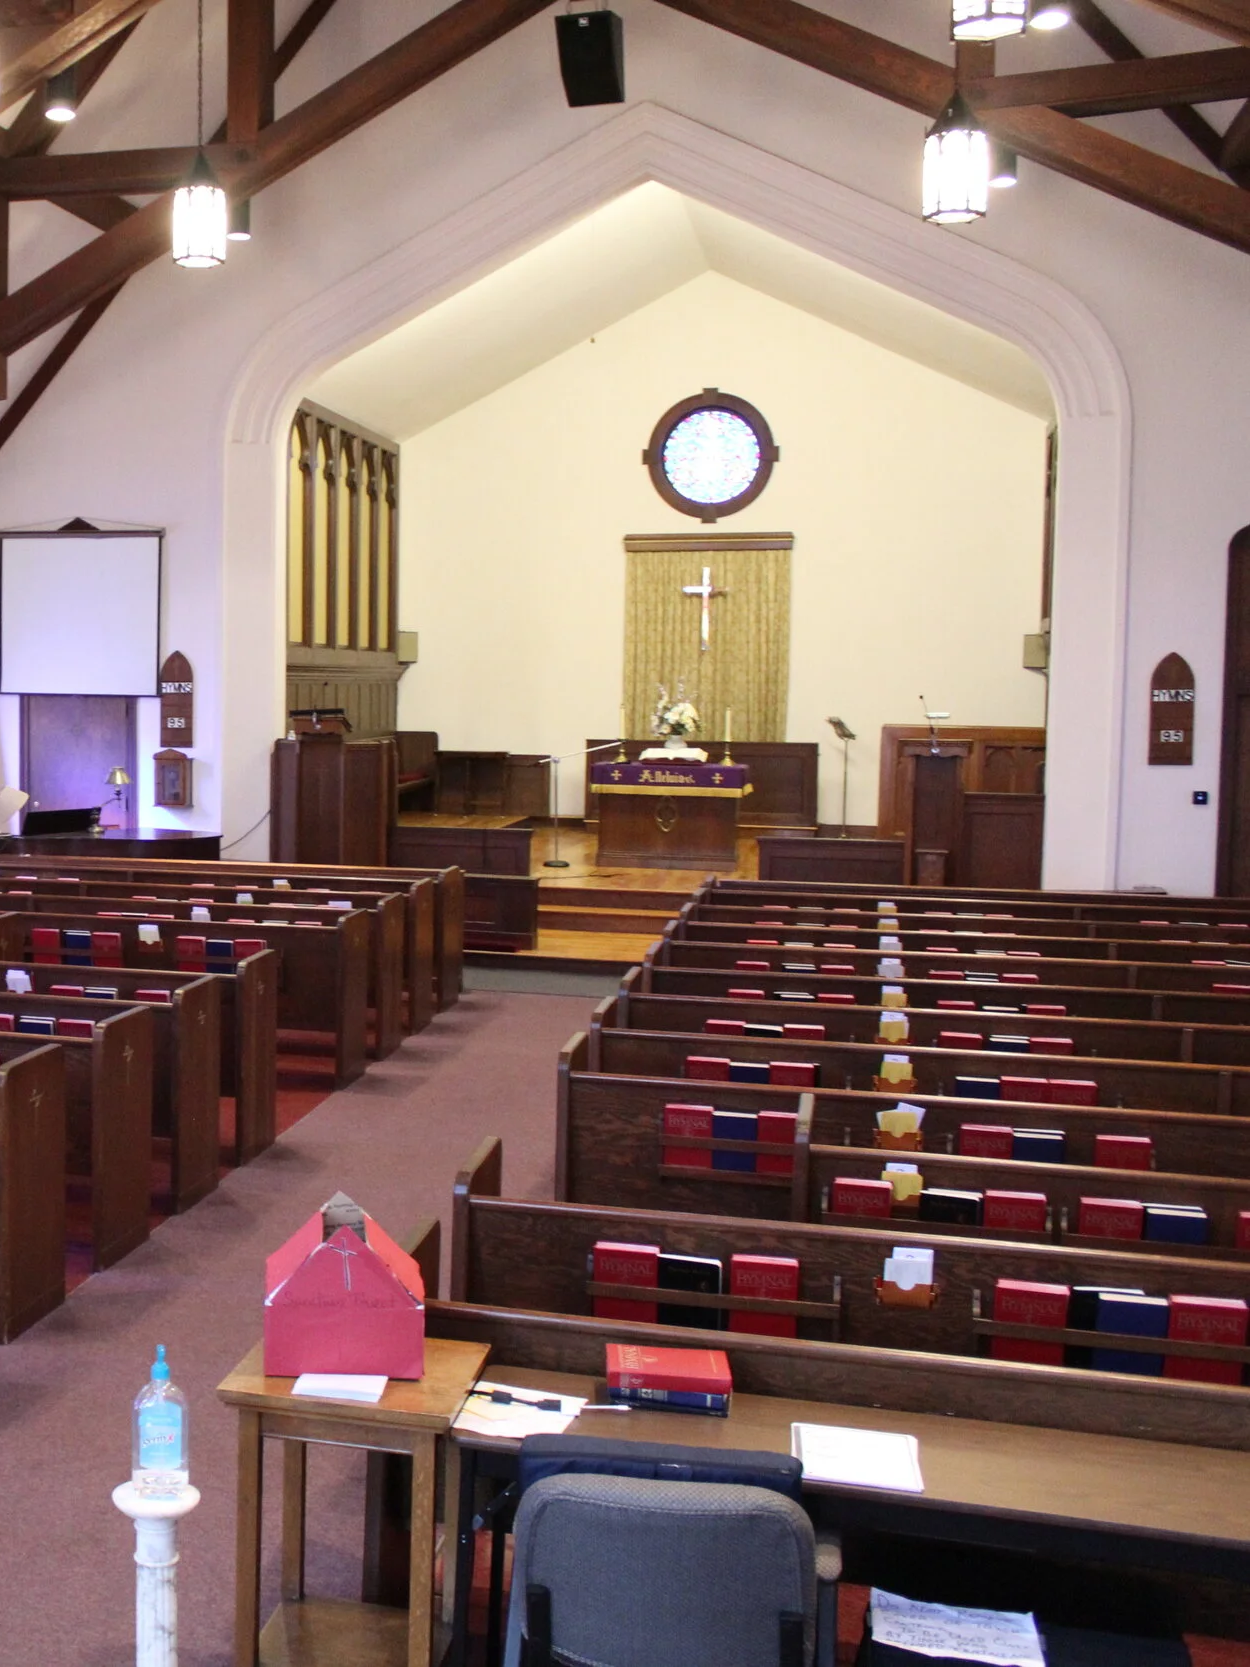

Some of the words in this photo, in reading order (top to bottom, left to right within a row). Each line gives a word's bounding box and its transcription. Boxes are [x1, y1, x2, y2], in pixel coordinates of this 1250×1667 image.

[161, 682, 193, 693] HYMNS
[1152, 690, 1195, 701] HYMNS
[168, 717, 185, 728] 95
[1162, 731, 1183, 742] 95
[736, 1270, 793, 1287] HYMNAL
